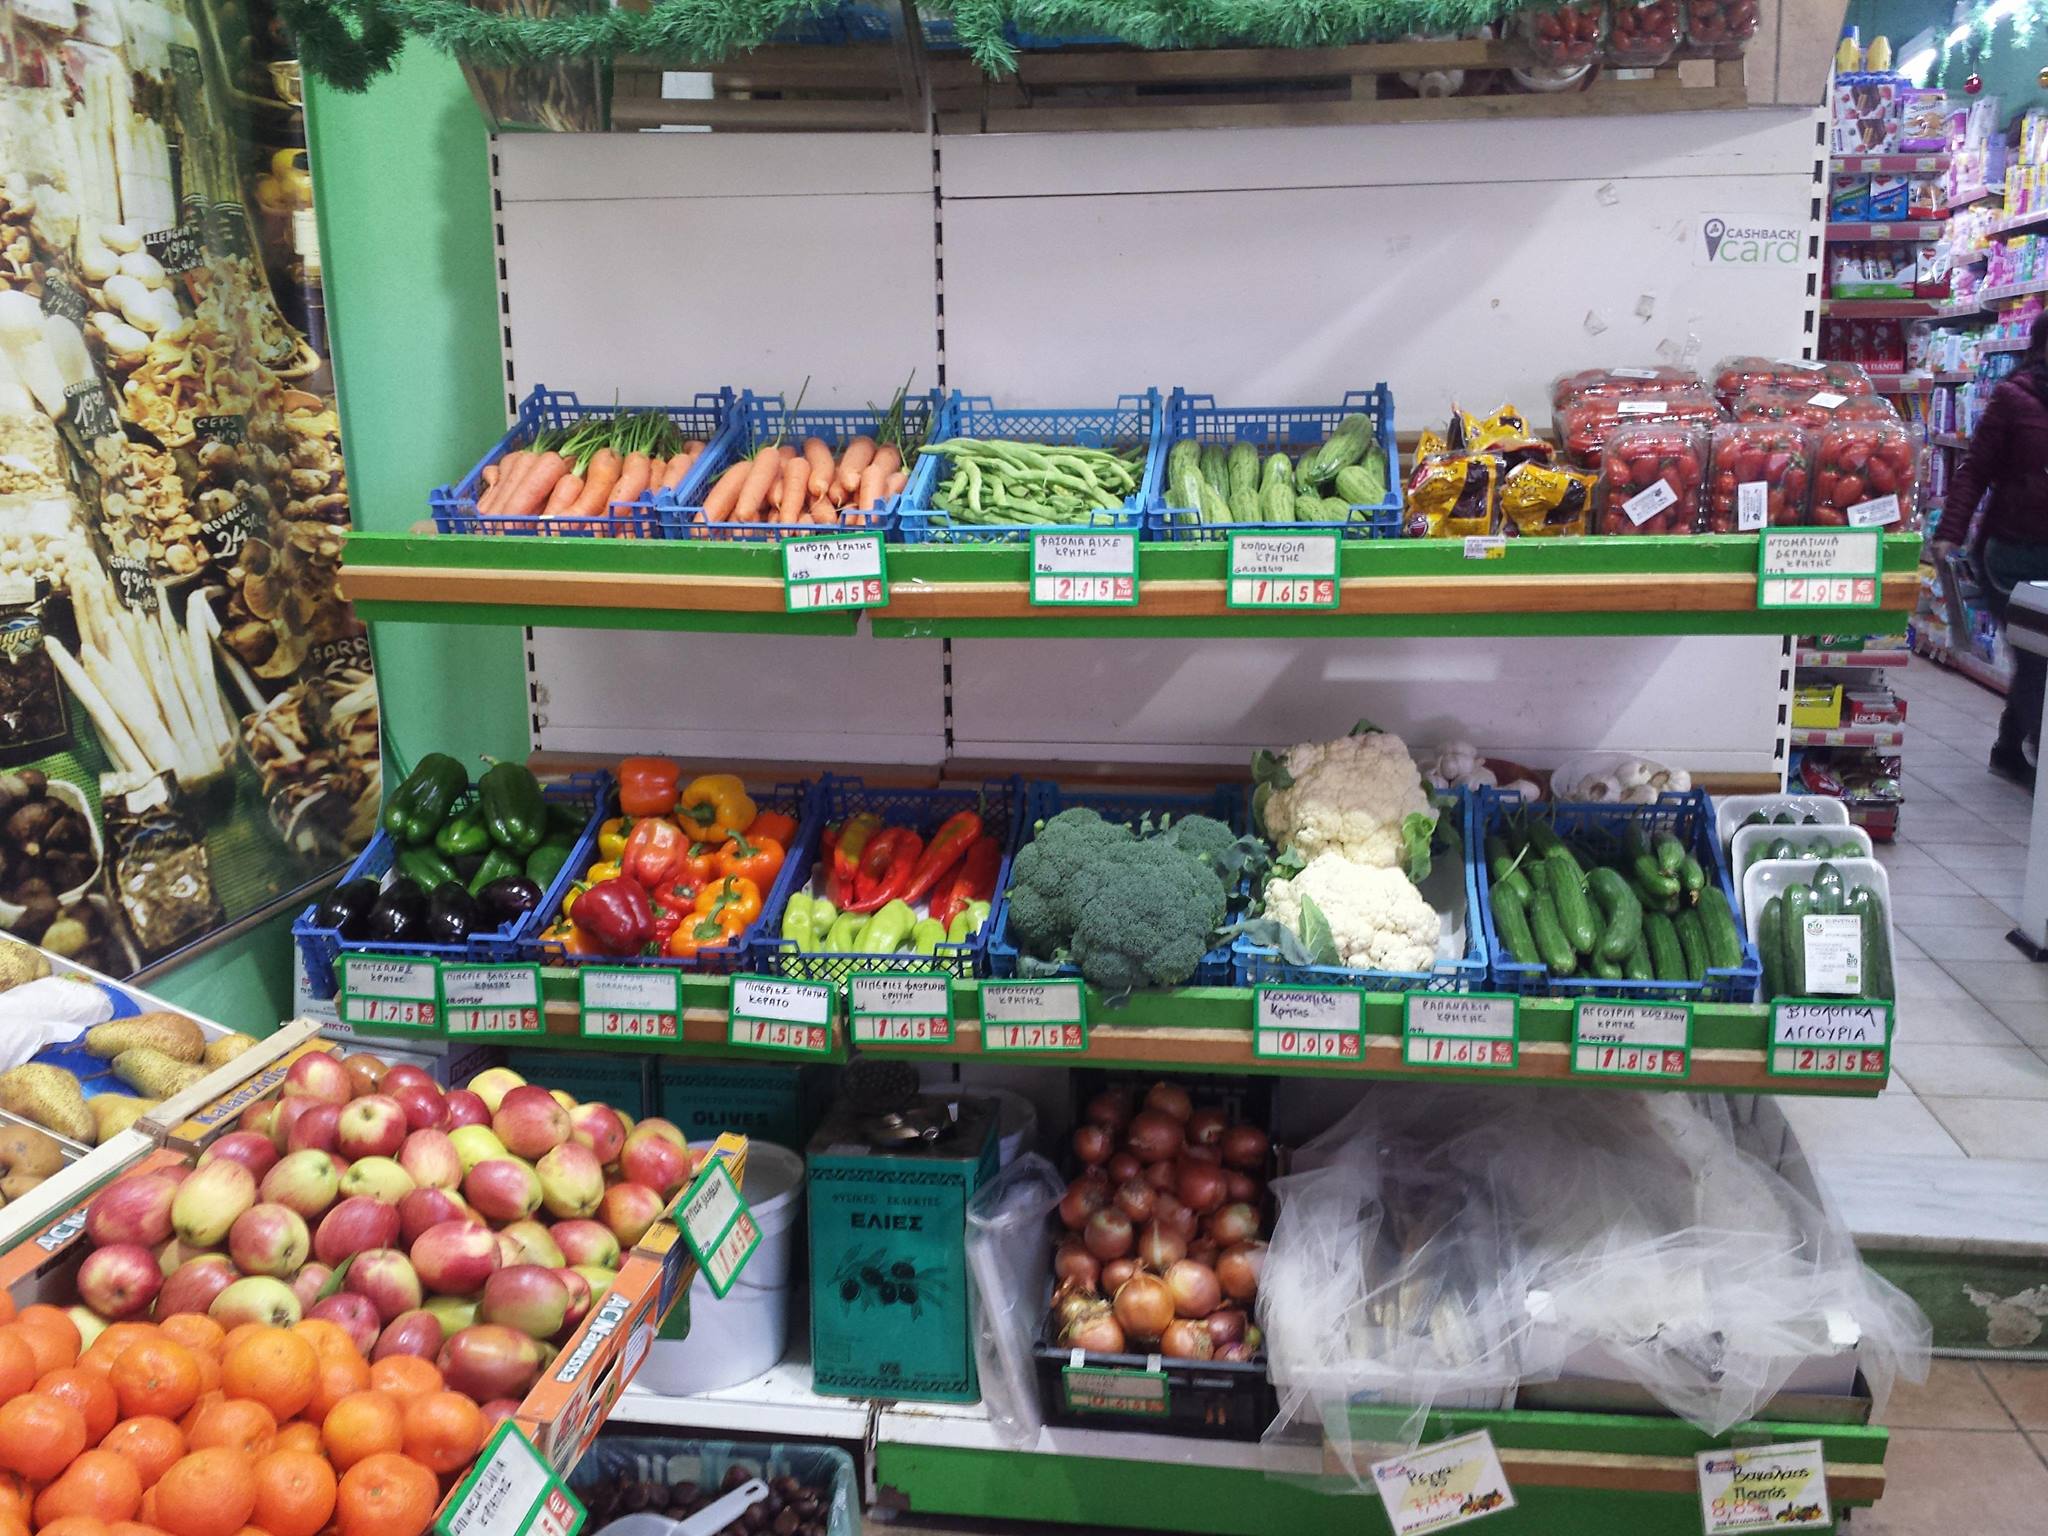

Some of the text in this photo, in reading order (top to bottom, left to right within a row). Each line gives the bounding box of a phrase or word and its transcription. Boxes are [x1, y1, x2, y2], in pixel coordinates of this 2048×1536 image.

[1726, 228, 1796, 240] CASHBACK
[1720, 230, 1801, 263] card
[196, 417, 238, 429] CEPS
[1058, 578, 1110, 600] 2.15
[1257, 580, 1309, 602] 1.65
[1789, 579, 1848, 602] 2.95
[607, 1012, 655, 1035] 3.45
[878, 1018, 926, 1038] 1.65
[1784, 1025, 1866, 1041] ΑΓΓΟΥΡΙΑ
[1281, 1032, 1334, 1054] 0.99
[1433, 1040, 1487, 1062] 1.65
[1602, 1047, 1658, 1071] 1.85
[1798, 1049, 1857, 1072] 2.35
[693, 1110, 771, 1127] OLIVES
[851, 1212, 924, 1232] ΕΛΙΕΣ
